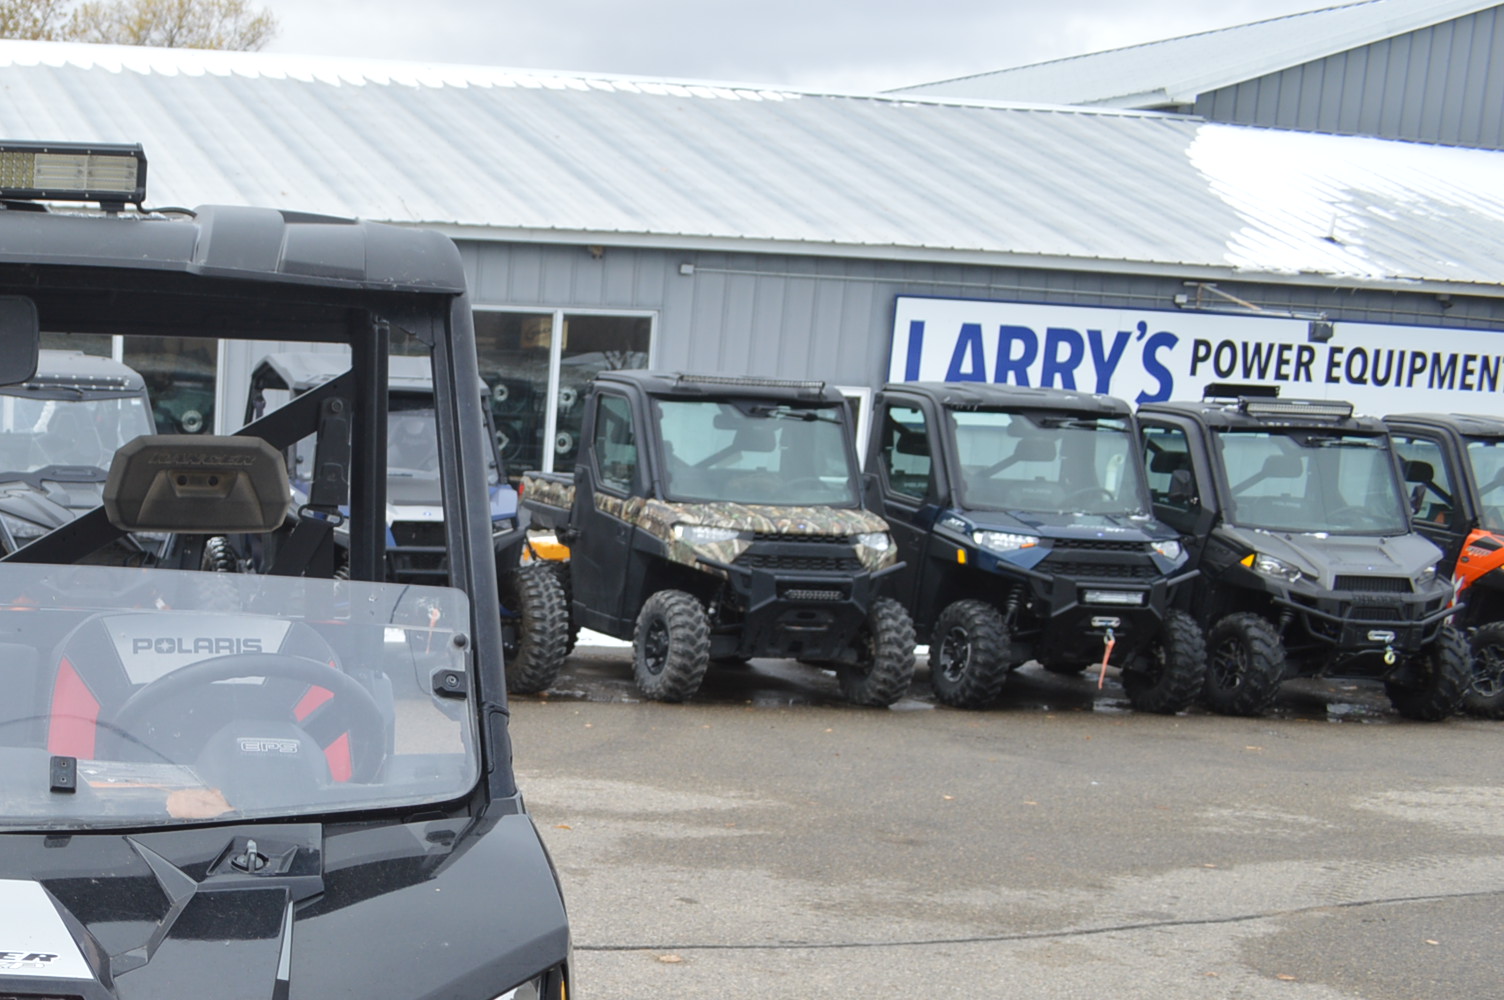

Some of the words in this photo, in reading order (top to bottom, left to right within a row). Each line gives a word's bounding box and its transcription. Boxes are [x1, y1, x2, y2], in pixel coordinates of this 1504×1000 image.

[904, 319, 1180, 404] LARRY'S
[1189, 338, 1316, 383] POWER
[1324, 345, 1504, 393] EQUIPMEN
[132, 637, 264, 655] POLARIS
[240, 741, 298, 753] EPS
